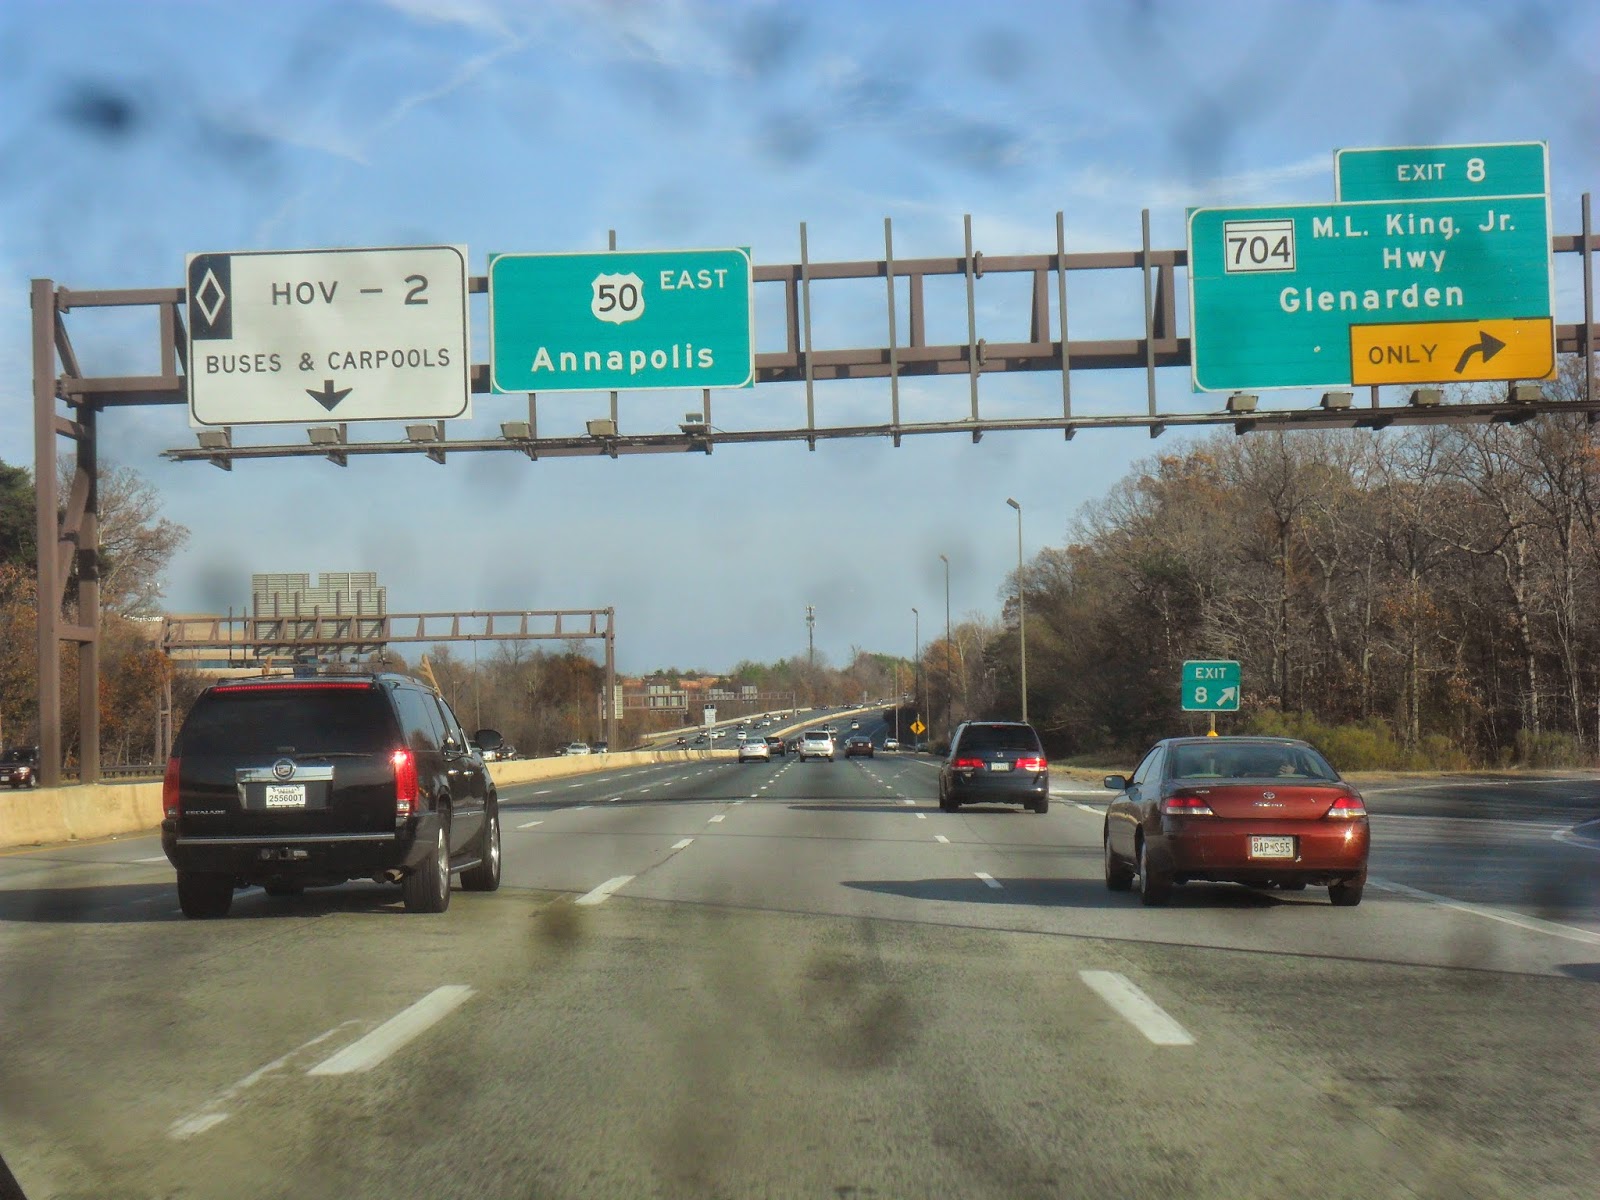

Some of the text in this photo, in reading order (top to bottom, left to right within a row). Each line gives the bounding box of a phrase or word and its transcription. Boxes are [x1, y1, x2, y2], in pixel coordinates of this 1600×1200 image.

[1397, 157, 1486, 183] EXIT 8
[1312, 217, 1369, 239] M.L.
[1478, 209, 1516, 233] Jr.
[1228, 236, 1291, 265] 704
[1383, 247, 1447, 272] Hwy
[271, 280, 338, 306] HOV
[403, 274, 429, 305] 2
[660, 269, 728, 290] EAST
[598, 283, 638, 313] 50
[1279, 283, 1464, 313] Glenarden
[206, 348, 451, 374] BUSES & CARPOOLS
[531, 343, 714, 376] Annapolis
[1368, 344, 1438, 366] ONLY
[1195, 667, 1227, 679] EXIT
[1194, 686, 1208, 703] 8
[269, 794, 304, 803] 255600T
